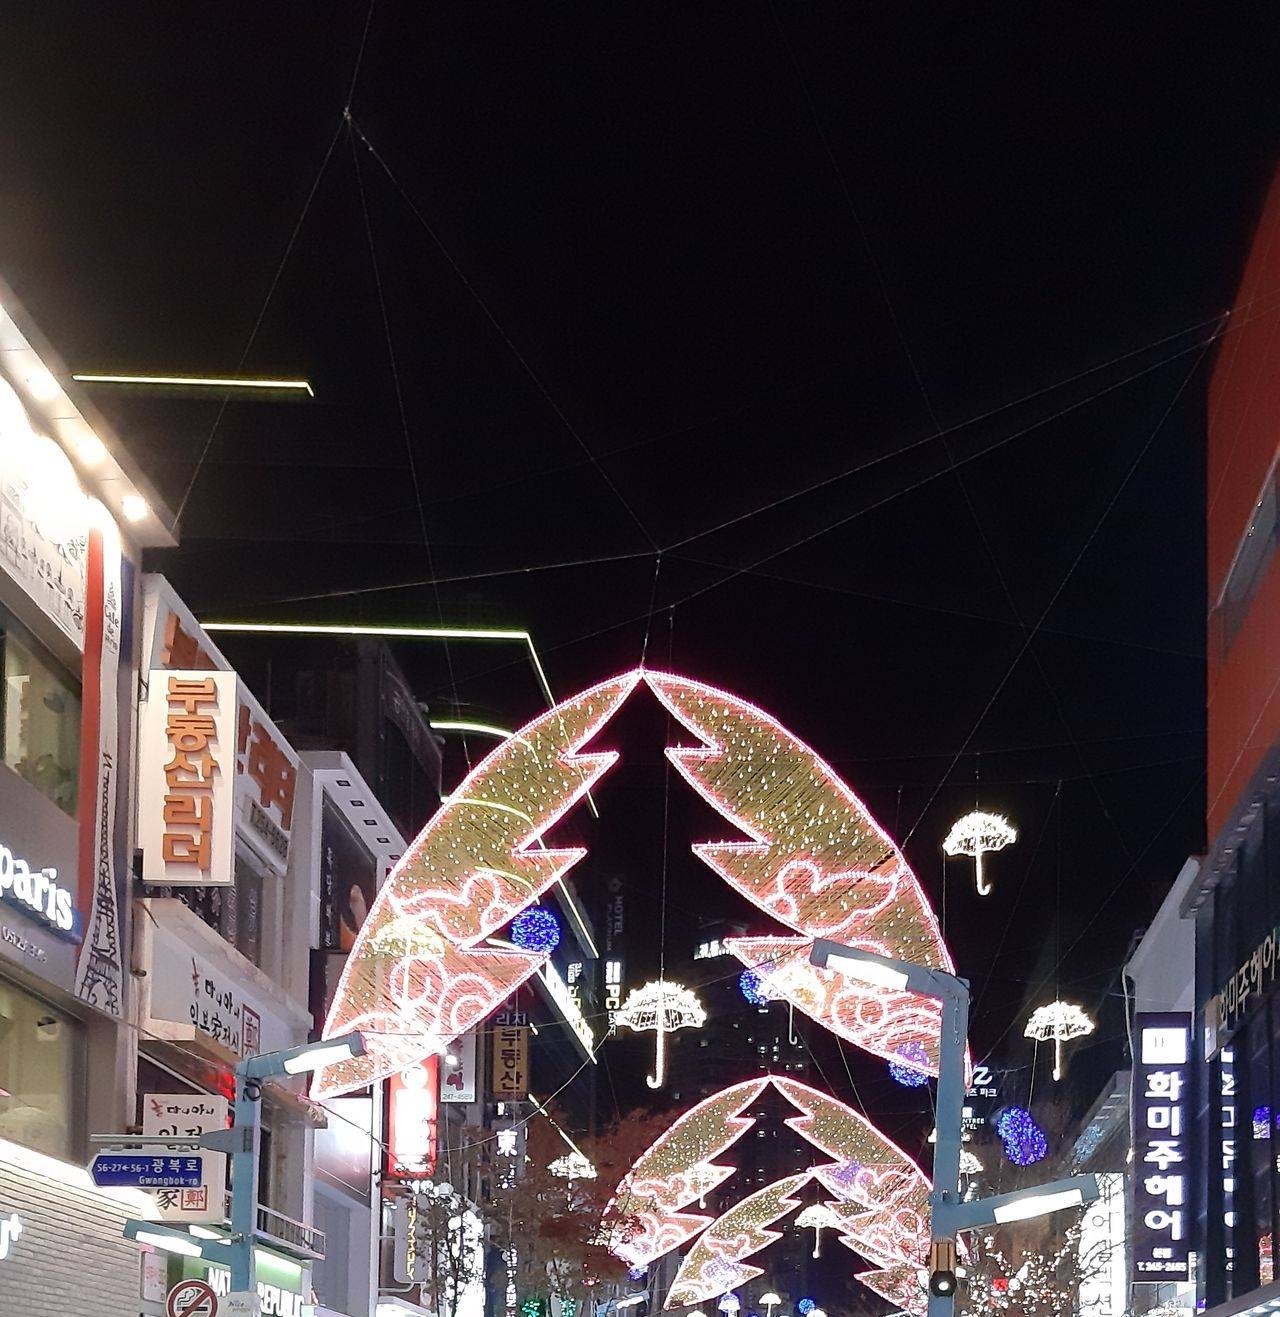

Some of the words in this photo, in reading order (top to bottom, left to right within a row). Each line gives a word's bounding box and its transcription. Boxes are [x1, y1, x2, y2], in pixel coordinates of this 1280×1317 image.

[163, 676, 220, 873] 부동산리더
[614, 896, 624, 937] HOTEL
[605, 984, 621, 1010] PC
[501, 1026, 522, 1092] 부동산
[139, 1175, 198, 1187] Gwangbok-ro
[1143, 1070, 1184, 1241] 화미주헤어
